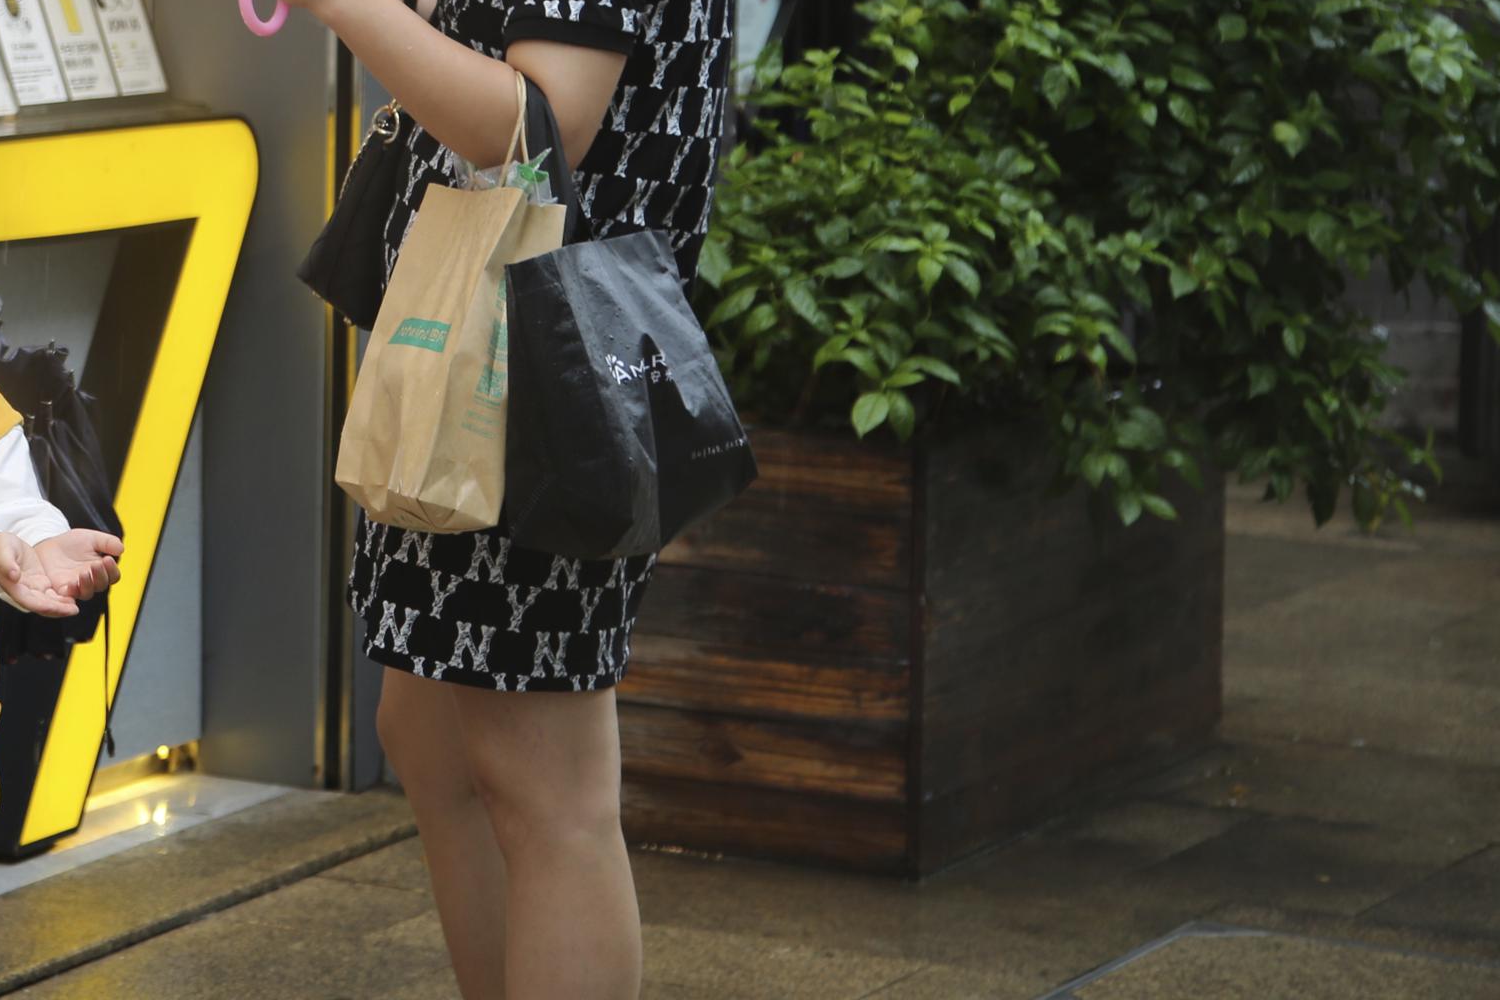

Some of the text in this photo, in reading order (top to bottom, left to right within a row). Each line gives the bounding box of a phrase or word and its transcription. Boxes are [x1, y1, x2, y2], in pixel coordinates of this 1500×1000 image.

[650, 41, 683, 89] Y
[373, 600, 420, 655] N
[506, 583, 542, 634] Y
[448, 620, 497, 673] N
[531, 631, 572, 679] N
